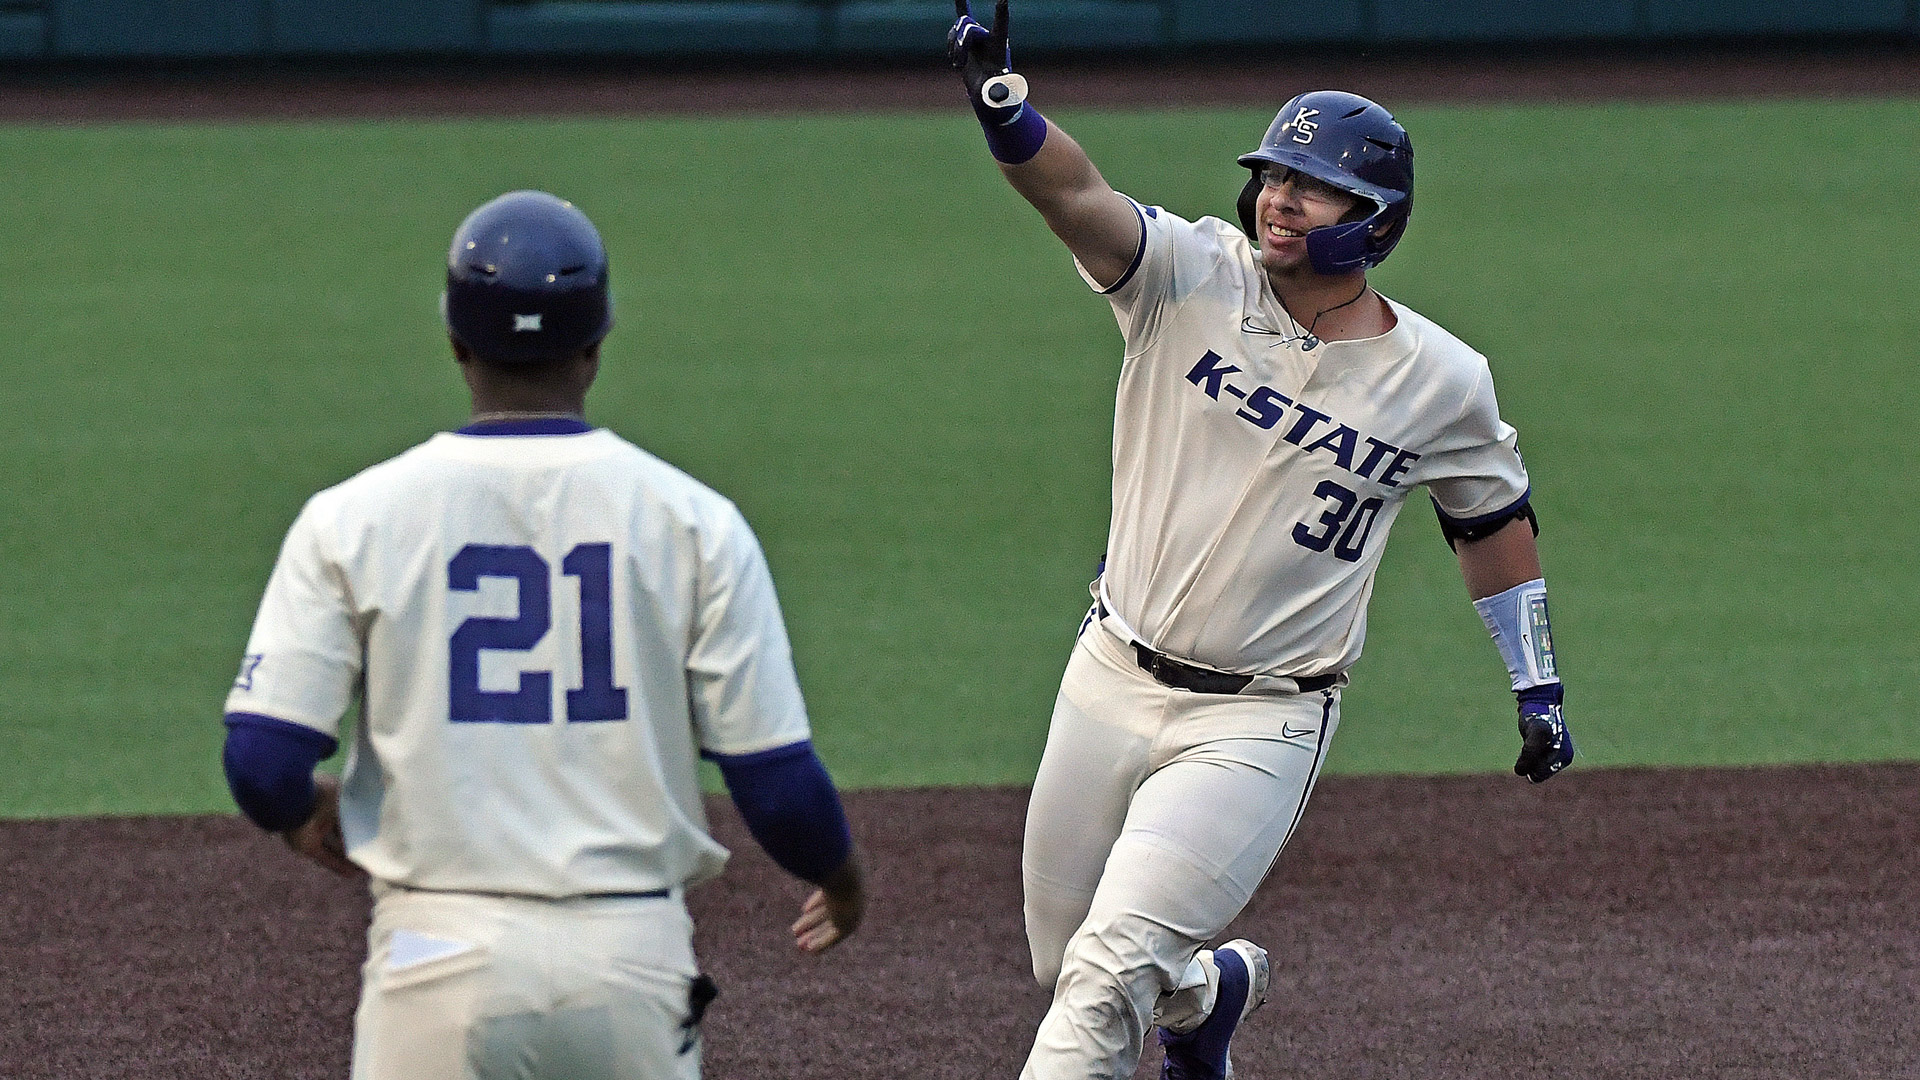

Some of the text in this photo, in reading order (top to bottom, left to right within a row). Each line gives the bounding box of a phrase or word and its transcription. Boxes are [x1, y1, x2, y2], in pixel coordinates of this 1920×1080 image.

[1185, 349, 1421, 487] K-STATE
[1291, 480, 1384, 562] 30
[448, 542, 628, 723] 21
